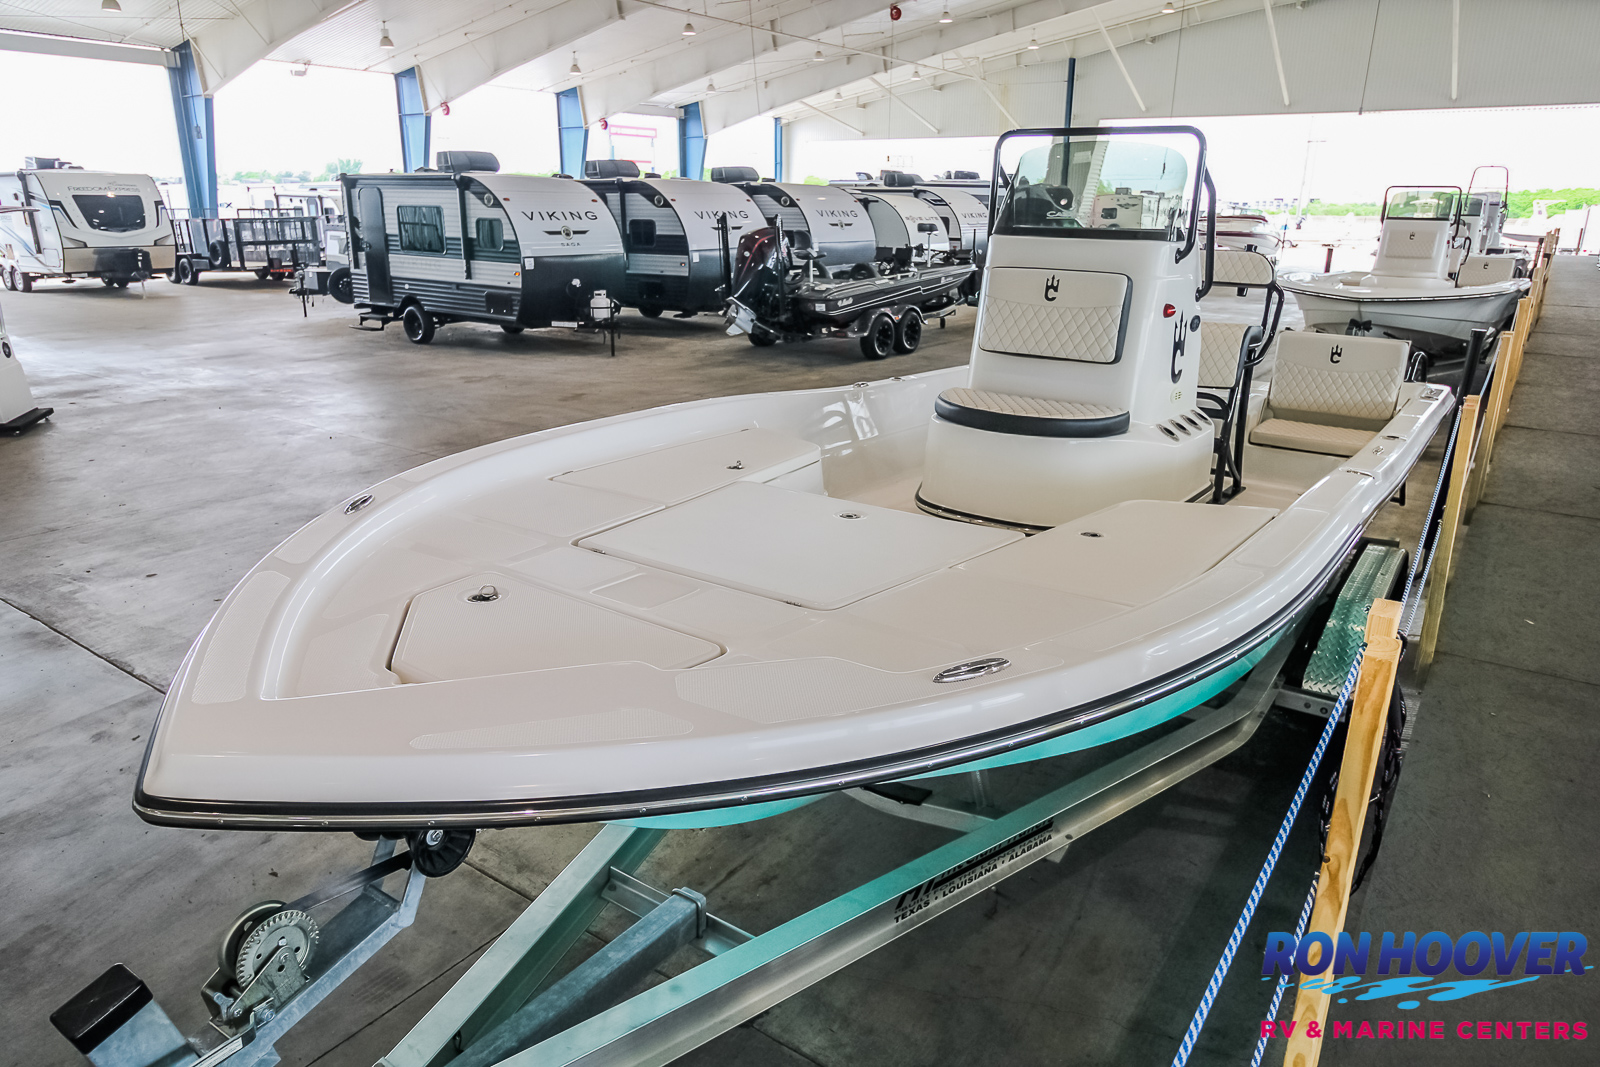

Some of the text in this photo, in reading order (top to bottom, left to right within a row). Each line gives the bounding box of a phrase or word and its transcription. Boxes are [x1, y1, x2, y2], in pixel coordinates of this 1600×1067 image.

[521, 211, 598, 221] VIKING
[815, 209, 859, 218] VIKING
[894, 834, 1053, 923] TEXAS LOUISIANA ALABAMA
[934, 881, 955, 895] FOR
[959, 868, 977, 881] THE
[980, 848, 1016, 870] LONG
